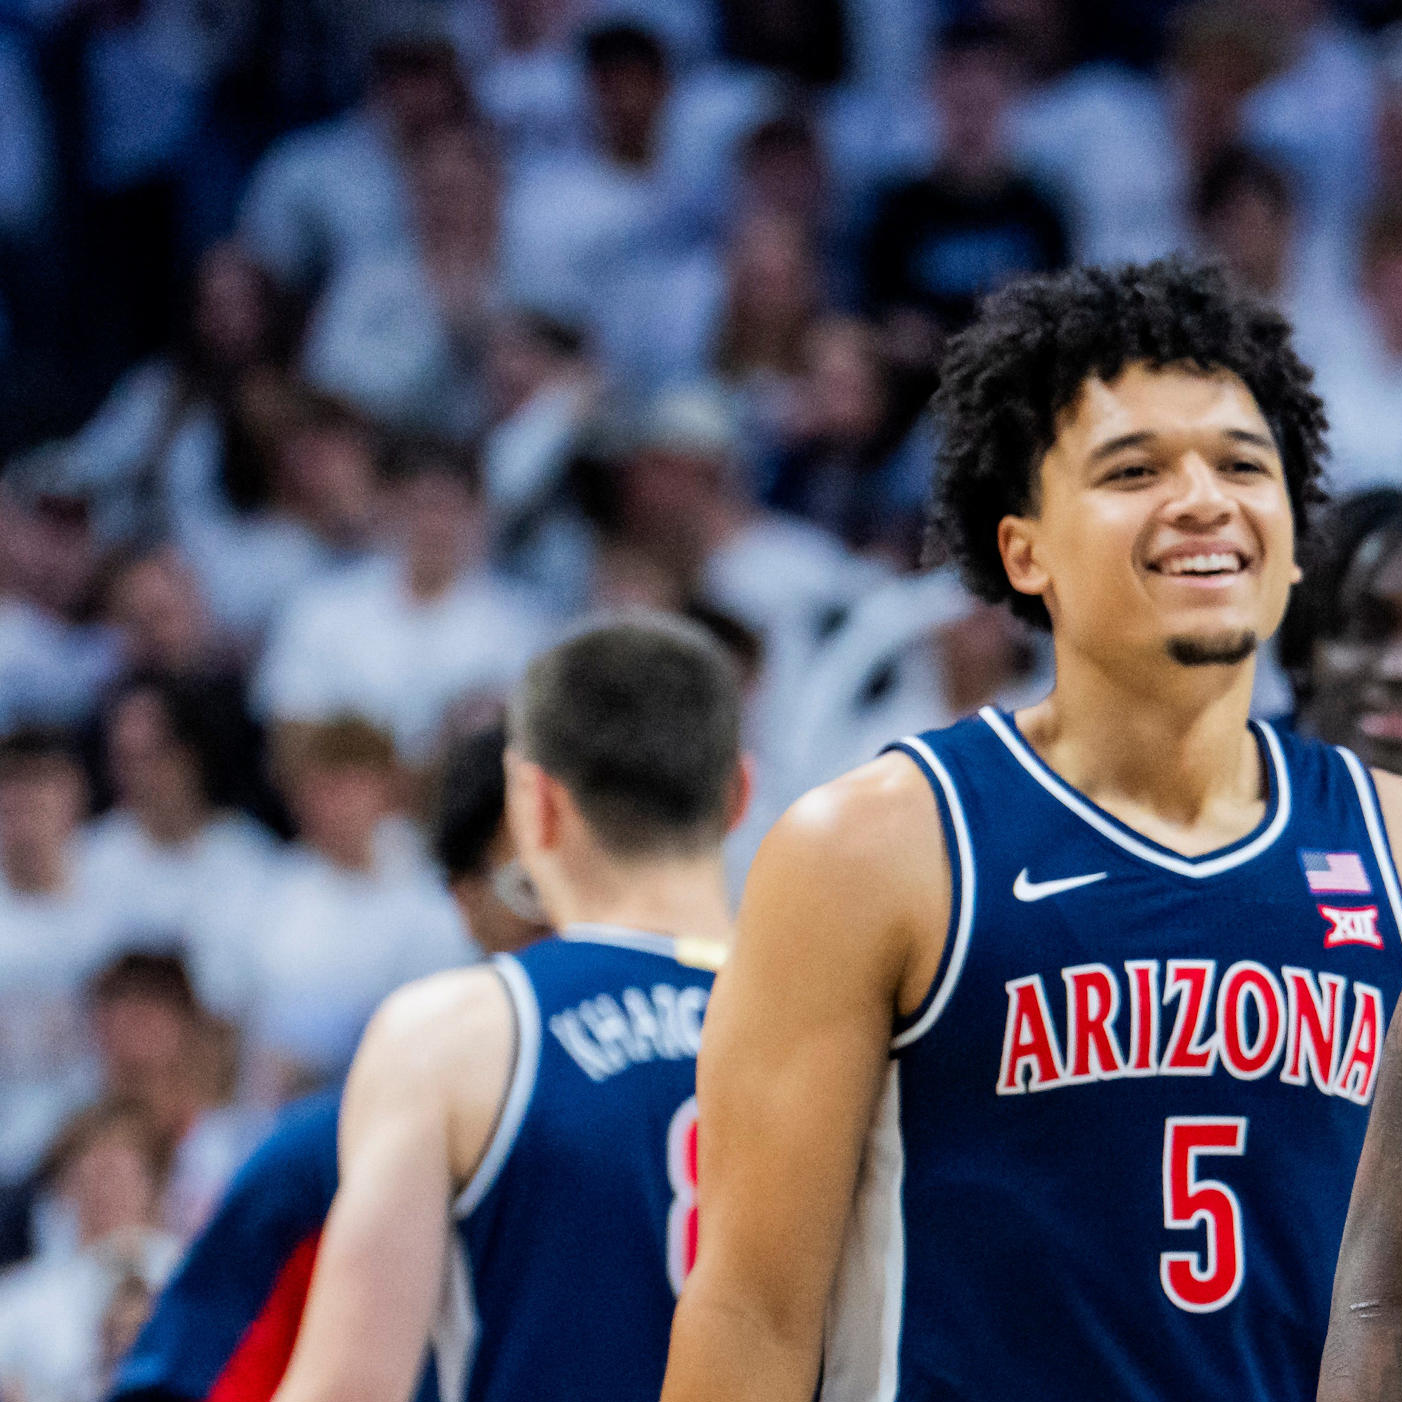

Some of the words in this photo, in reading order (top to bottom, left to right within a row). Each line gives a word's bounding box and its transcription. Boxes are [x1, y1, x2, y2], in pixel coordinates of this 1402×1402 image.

[1320, 905, 1382, 947] XII
[996, 959, 1383, 1105] ARIZONA
[1160, 1116, 1247, 1314] 5
